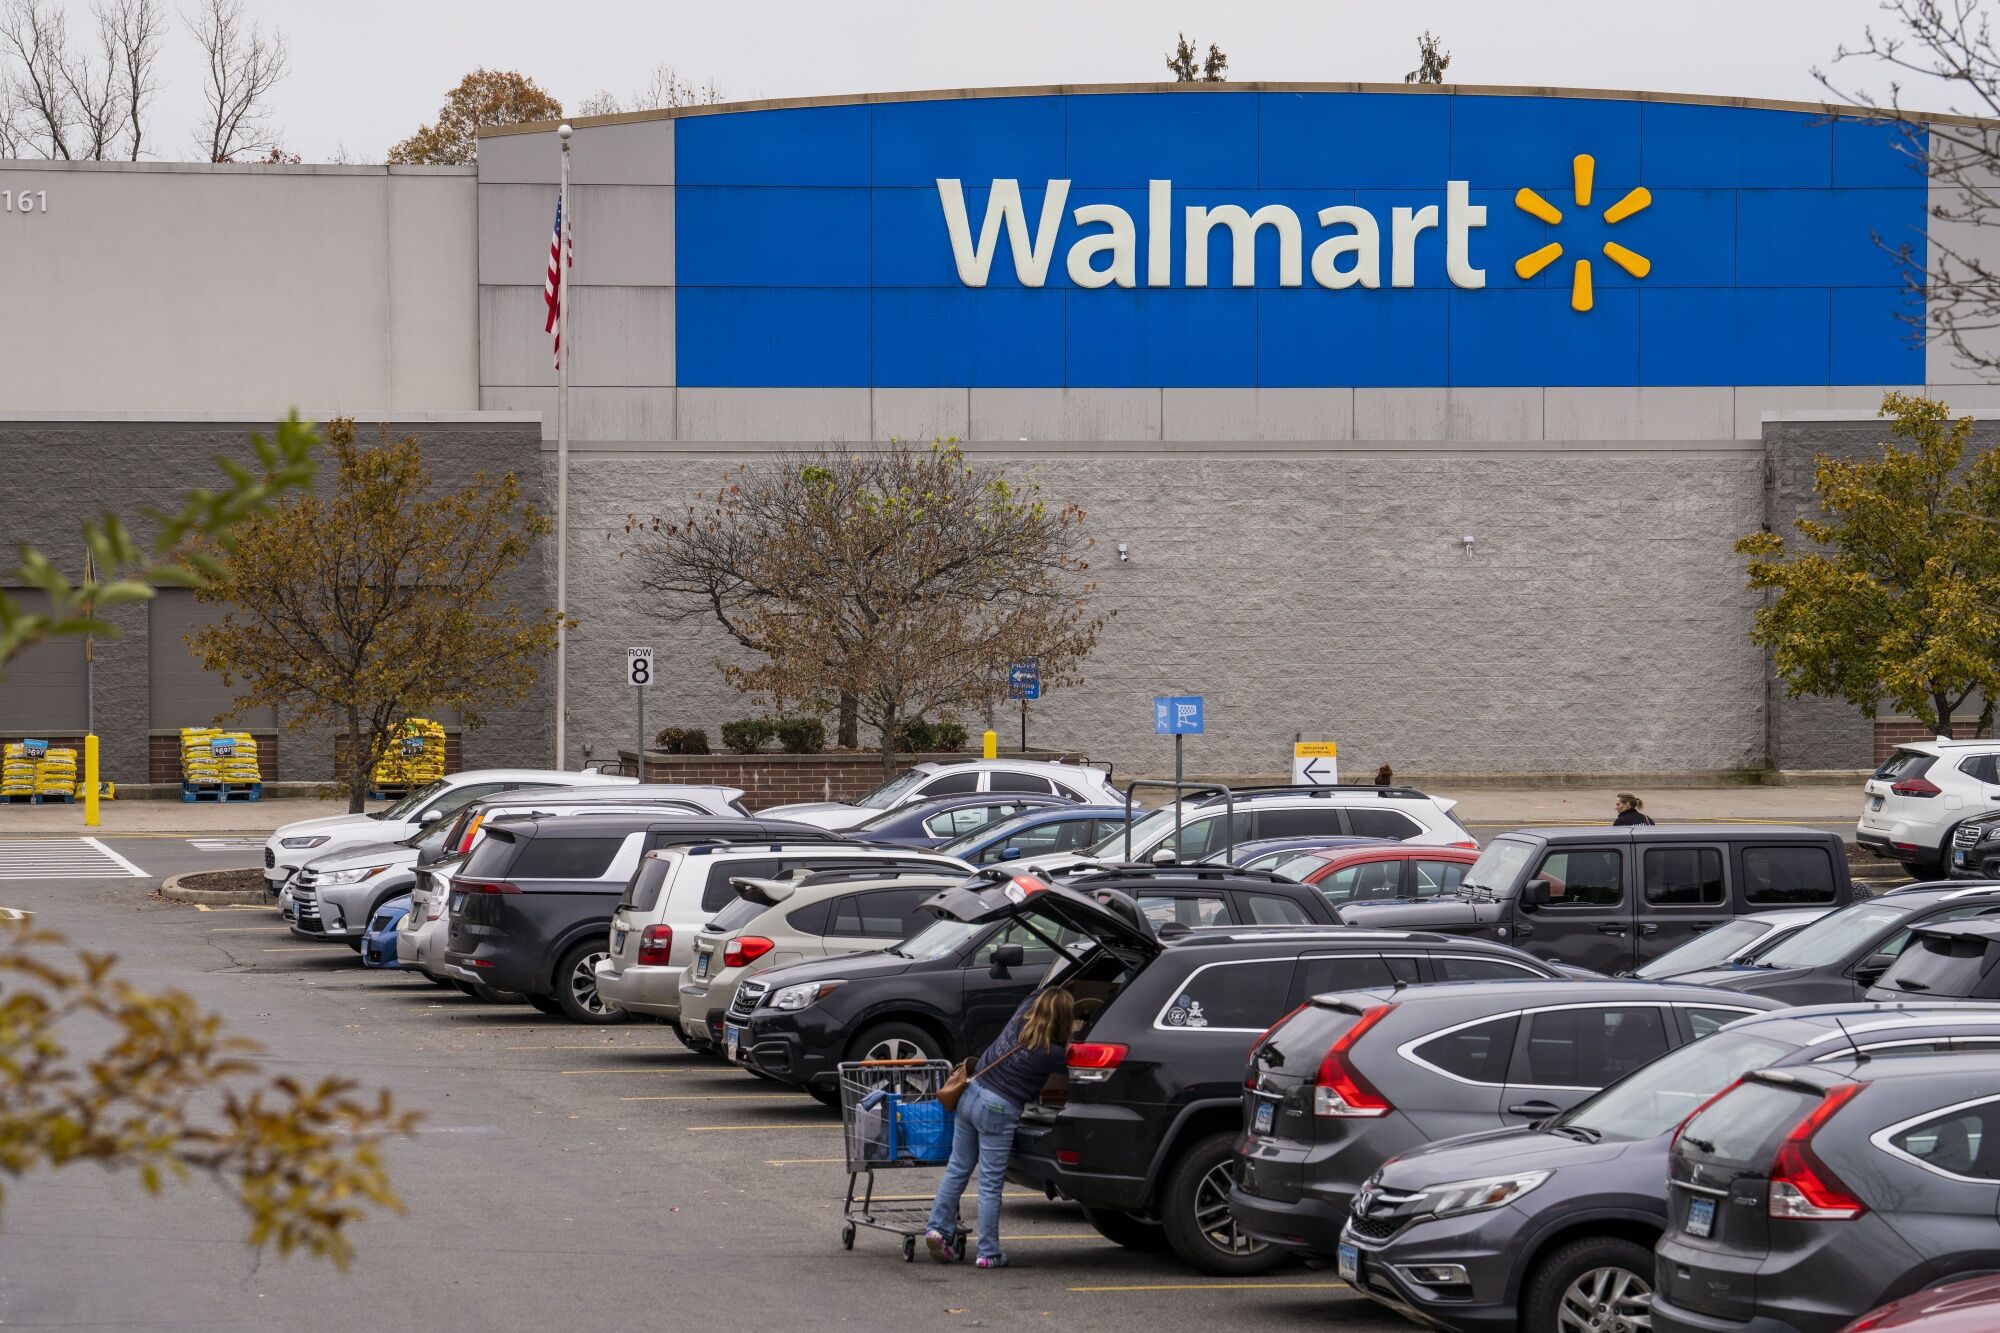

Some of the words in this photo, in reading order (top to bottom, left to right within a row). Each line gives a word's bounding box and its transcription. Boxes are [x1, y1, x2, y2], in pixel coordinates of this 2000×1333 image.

[2, 190, 47, 212] 161
[936, 178, 1487, 288] Walmart
[628, 648, 652, 657] ROW
[632, 658, 649, 684] 8
